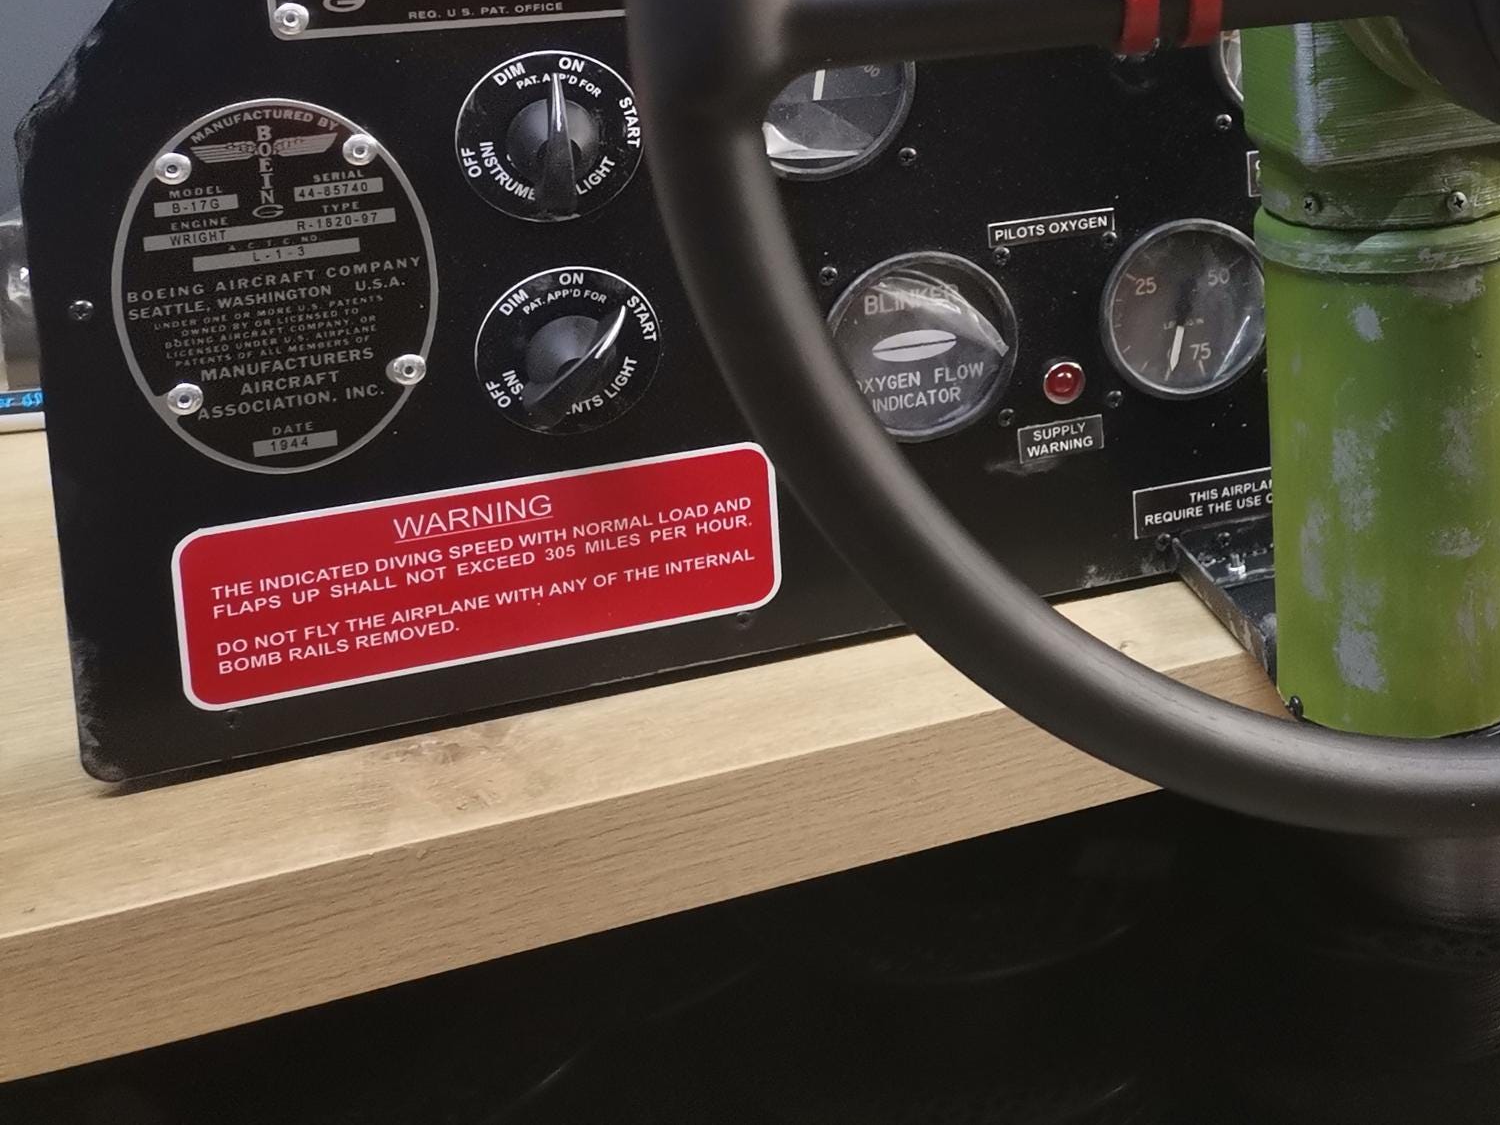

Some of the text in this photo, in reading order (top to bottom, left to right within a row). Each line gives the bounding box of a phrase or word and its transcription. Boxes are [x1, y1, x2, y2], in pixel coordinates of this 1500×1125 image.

[481, 5, 509, 15] PAT.
[515, 3, 563, 13] OFFICE
[493, 63, 525, 86] DIM
[559, 57, 585, 72] ON
[516, 74, 601, 97] PAT. AP'D FOR
[190, 109, 338, 144] MANUFACTURED BY
[619, 97, 640, 148] START
[252, 125, 284, 218] BOEING
[461, 148, 482, 178] OFF
[480, 142, 615, 200] INSTRUME LIGHT
[313, 170, 365, 183] SERIAL
[169, 186, 224, 199] MODEL
[298, 182, 368, 199] 44-85740
[172, 199, 220, 214] B-17G
[322, 202, 360, 213] TYPE
[170, 212, 377, 246] WRIGHT R-1820-97
[171, 218, 229, 231] ENGINE
[995, 216, 1108, 241] PILOTS OXYGEN
[127, 257, 421, 303] BOEING AIRCRAFT COMPANY
[559, 273, 584, 285] ON
[1135, 277, 1157, 295] 25
[1208, 268, 1230, 286] 50
[217, 285, 331, 309] WASHINGTON
[356, 276, 405, 292] U.S.A.
[500, 289, 529, 316] DIM
[523, 289, 607, 314] PAT. APP'D FOR
[154, 319, 196, 330] UNDER
[204, 314, 227, 324] ONE
[257, 307, 292, 316] MORE
[329, 295, 383, 308] PATENTS
[181, 325, 226, 337] OWNED
[233, 322, 248, 330] BY
[255, 318, 270, 327] OR
[277, 311, 338, 324] LICENSED
[627, 296, 656, 342] START
[165, 336, 214, 349] BOEING
[220, 327, 283, 342] AIRCRAFT
[360, 315, 376, 323] OR
[166, 345, 229, 359] LICENSED
[236, 338, 278, 350] UNDER
[316, 325, 377, 339] AIRPLANE
[175, 354, 231, 366] PATENTS
[238, 351, 253, 359] OF
[261, 348, 282, 356] ALL
[288, 338, 350, 352] MEMBERS
[201, 347, 374, 382] MANUFACTURERS
[1190, 343, 1212, 360] 75
[240, 371, 339, 395] AIRCRAFT
[604, 356, 637, 399] LIGHT
[934, 362, 984, 384] FLOW
[346, 384, 384, 399] INC.
[486, 380, 511, 408] OFF
[872, 387, 962, 413] INDICATOR
[273, 422, 313, 435] DATE
[1033, 423, 1086, 441] SUPPLY
[271, 437, 309, 452] 1944
[1027, 436, 1093, 457] WARNING
[1189, 479, 1272, 503] THIS AIRPLA
[393, 494, 553, 540] WARNING
[1145, 496, 1262, 525] REQUIRE THE USE
[211, 497, 751, 600] THE INDICATED DIVING SPEED WITH NORMAL LOAD AND
[214, 515, 752, 619] FLAPS UP SHALL NOT EXCEED 305 MILES PER HOUR.
[217, 549, 754, 656] DO NOT FLY THE AIRPLANE WITH ANY OF THE INTERNAL
[219, 621, 460, 675] BOMB RAILS REMOVED.
